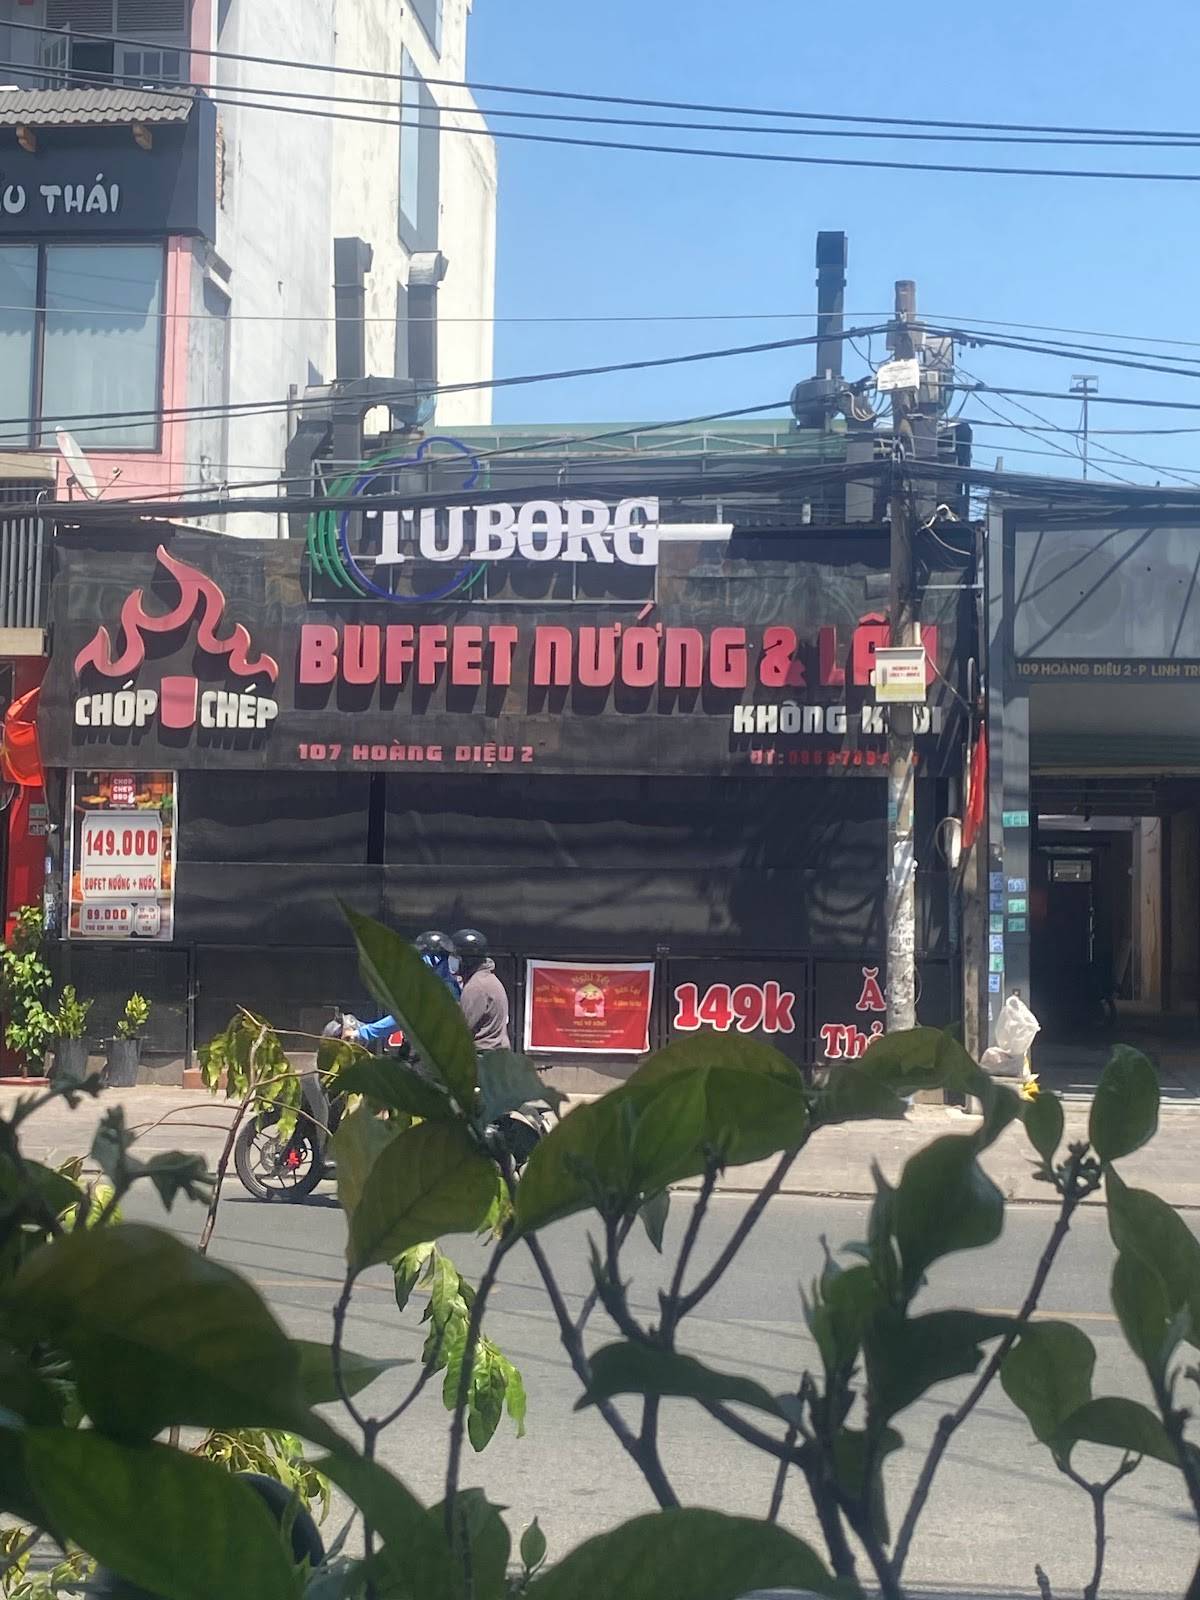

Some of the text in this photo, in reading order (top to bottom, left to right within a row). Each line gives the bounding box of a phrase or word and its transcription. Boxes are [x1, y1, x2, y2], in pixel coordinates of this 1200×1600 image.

[0, 173, 119, 214] U THÁI
[366, 496, 659, 566] TUBORG
[299, 623, 519, 685] BUFFET
[533, 601, 748, 689] NƯỚNG
[759, 625, 806, 688] &
[1017, 663, 1038, 675] 109
[1151, 664, 1180, 677] LINH
[74, 680, 279, 728] CHÓP CHÉP
[298, 738, 534, 768] 107 HOÀNG DIỆU 2
[86, 830, 158, 856] 149.000
[87, 909, 127, 920] 89.000
[674, 981, 796, 1034] 149k
